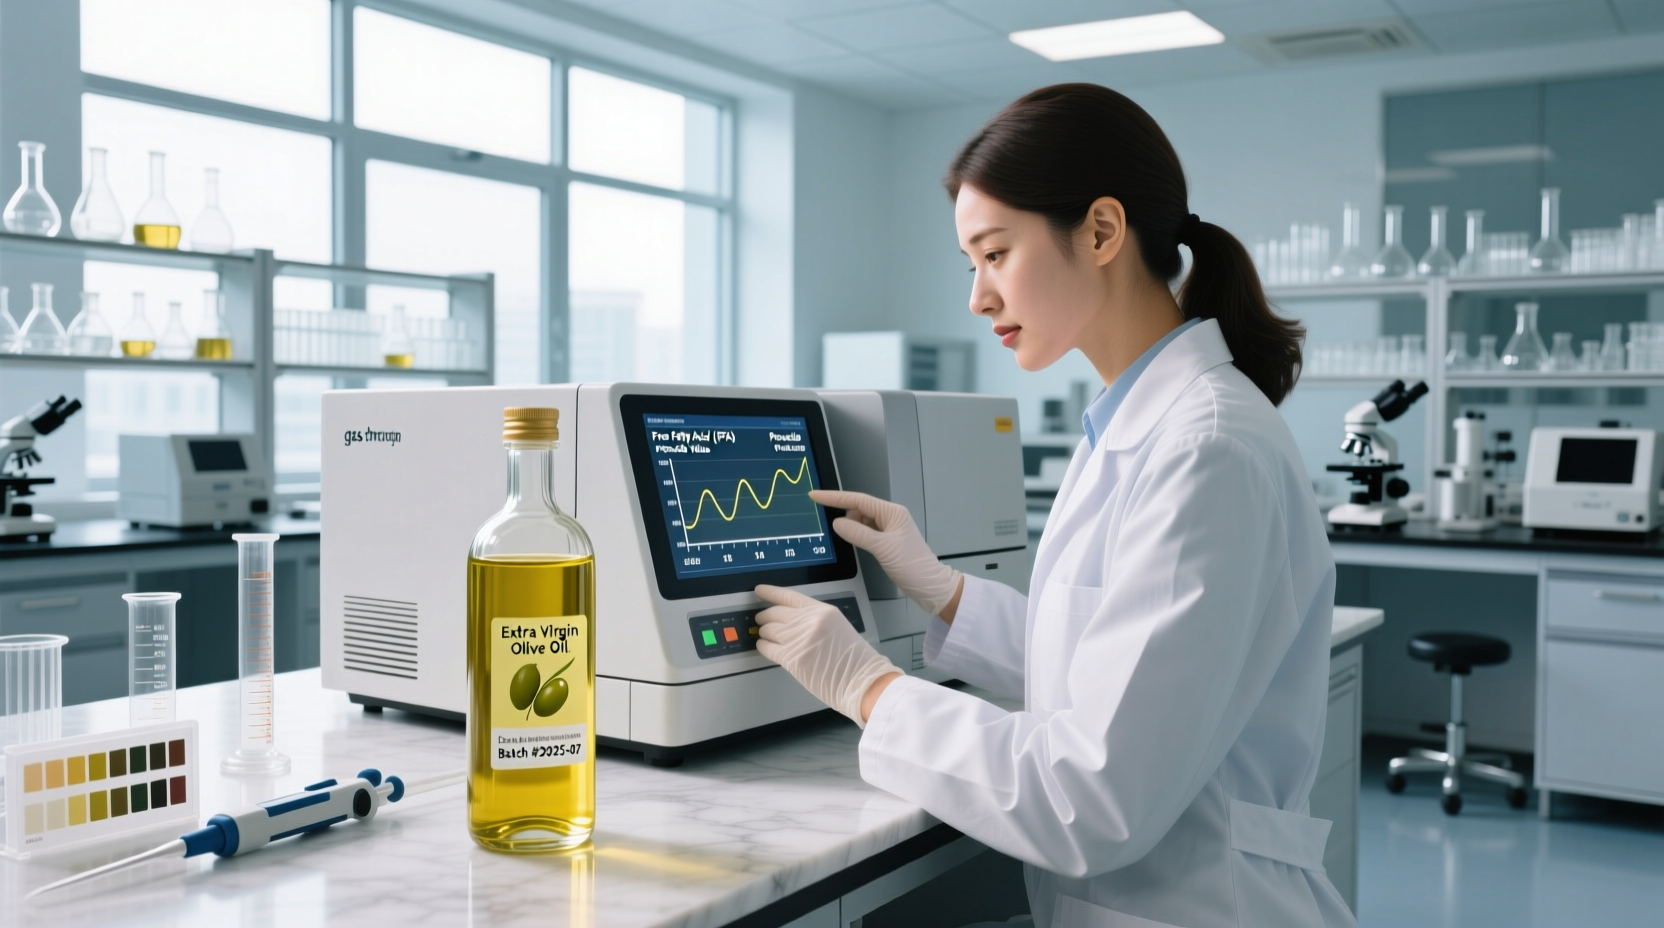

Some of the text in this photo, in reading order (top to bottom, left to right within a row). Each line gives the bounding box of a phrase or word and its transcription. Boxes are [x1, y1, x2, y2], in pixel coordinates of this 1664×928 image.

[501, 623, 579, 641] Extra Virgin
[511, 639, 569, 655] Olive Oil
[531, 743, 582, 758] #2025-07
